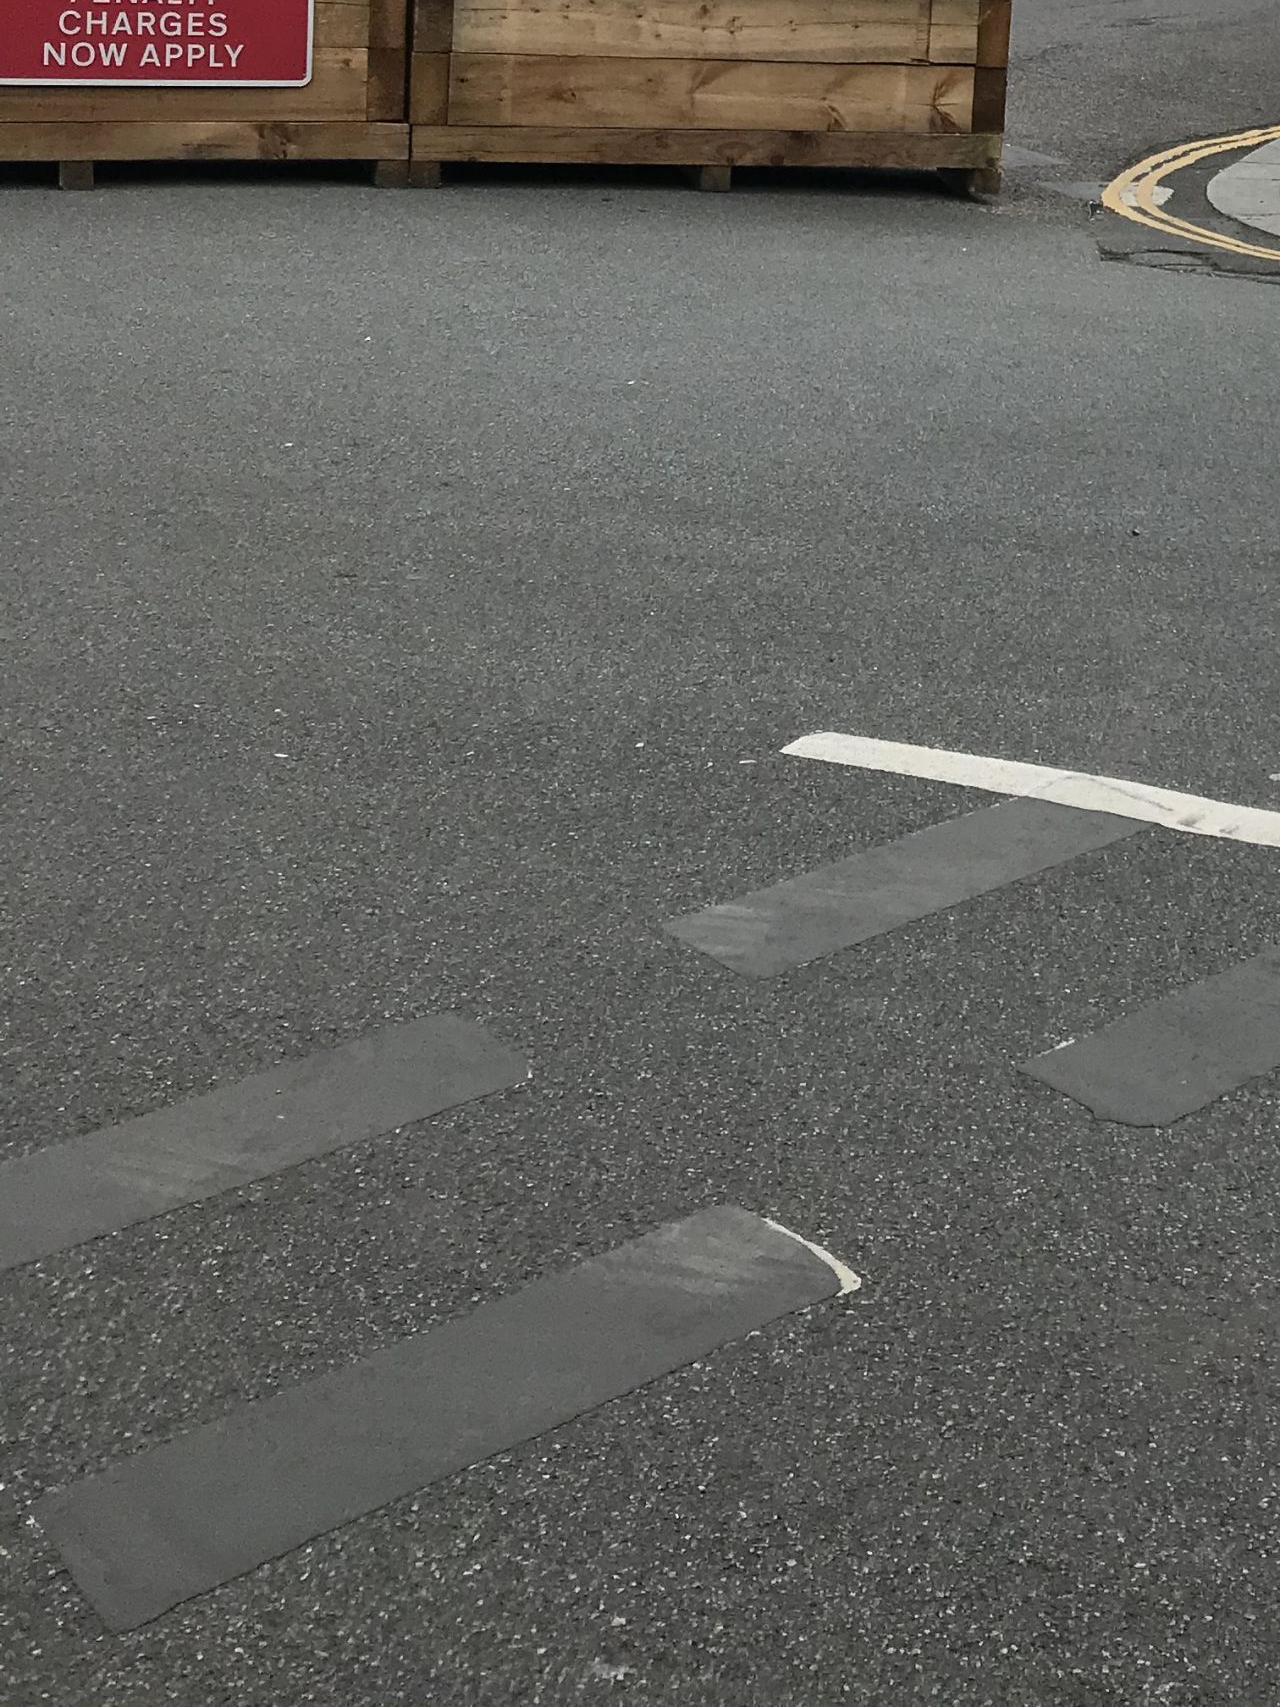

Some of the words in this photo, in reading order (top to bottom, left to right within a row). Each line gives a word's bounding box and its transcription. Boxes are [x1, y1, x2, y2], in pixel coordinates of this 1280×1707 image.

[58, 10, 228, 37] CHARGES
[43, 42, 128, 67] NOW
[139, 43, 244, 68] APPLY
